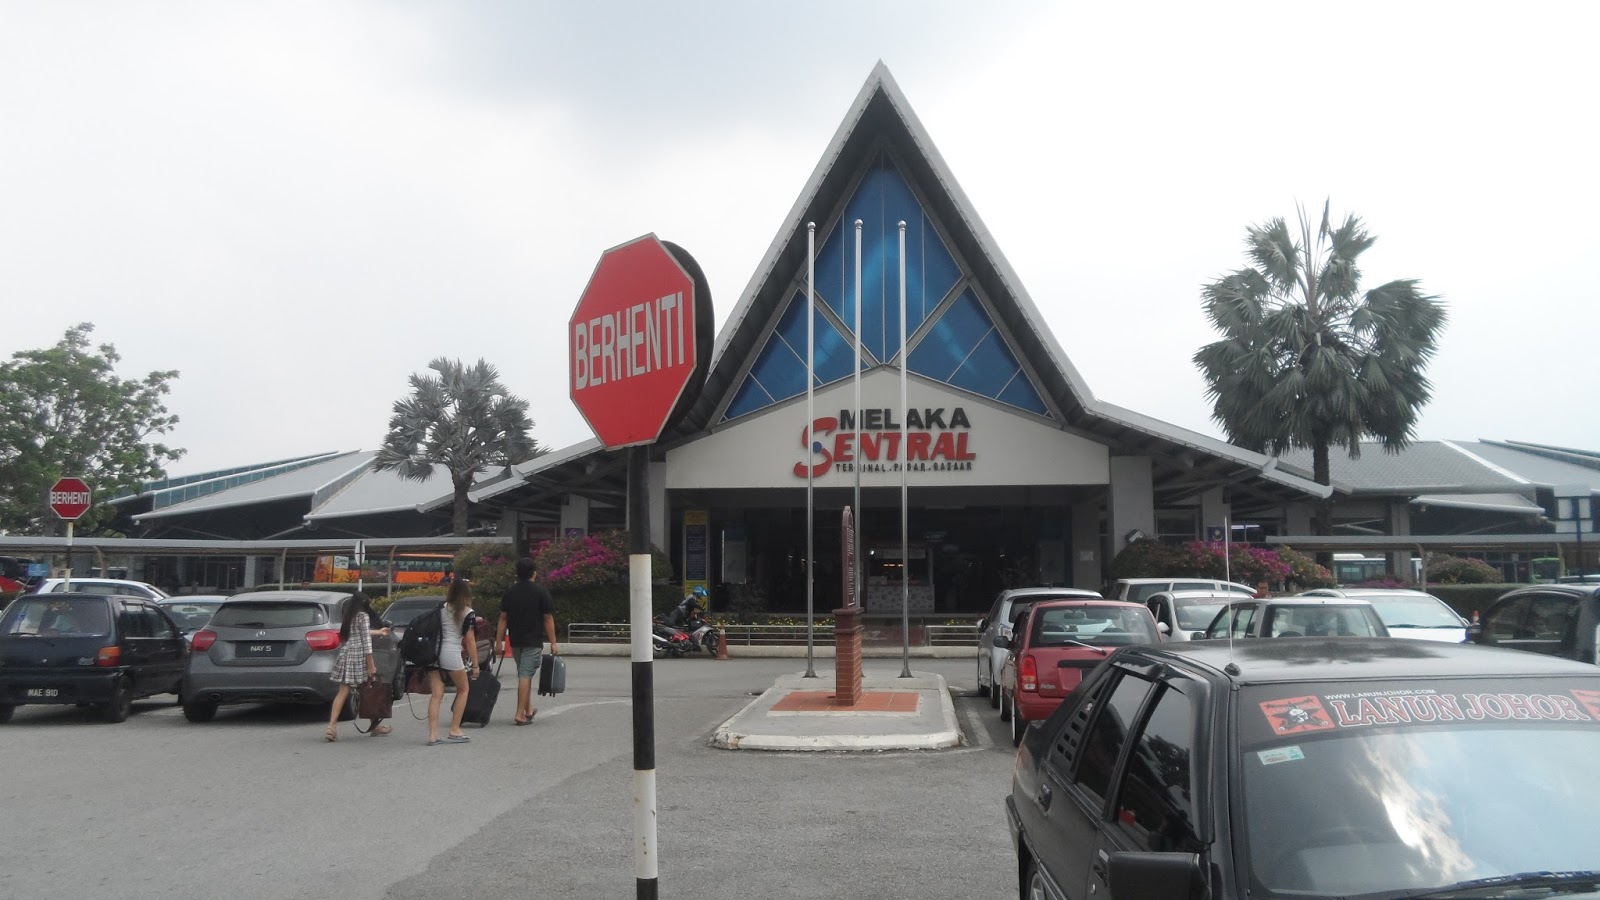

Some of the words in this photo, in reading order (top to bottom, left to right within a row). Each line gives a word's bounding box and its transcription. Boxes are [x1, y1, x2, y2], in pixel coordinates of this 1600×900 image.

[575, 291, 685, 390] BERHENTI
[840, 407, 971, 430] MELAKA
[793, 416, 977, 478] SENTRAL
[836, 463, 887, 473] TERINAL
[50, 492, 90, 504] BERHENTI
[27, 688, 43, 697] MAE
[1324, 688, 1437, 700] WWW.LANUNJOHOR.COM
[1330, 694, 1465, 727] LANUN
[1463, 693, 1591, 721] JOHOR
